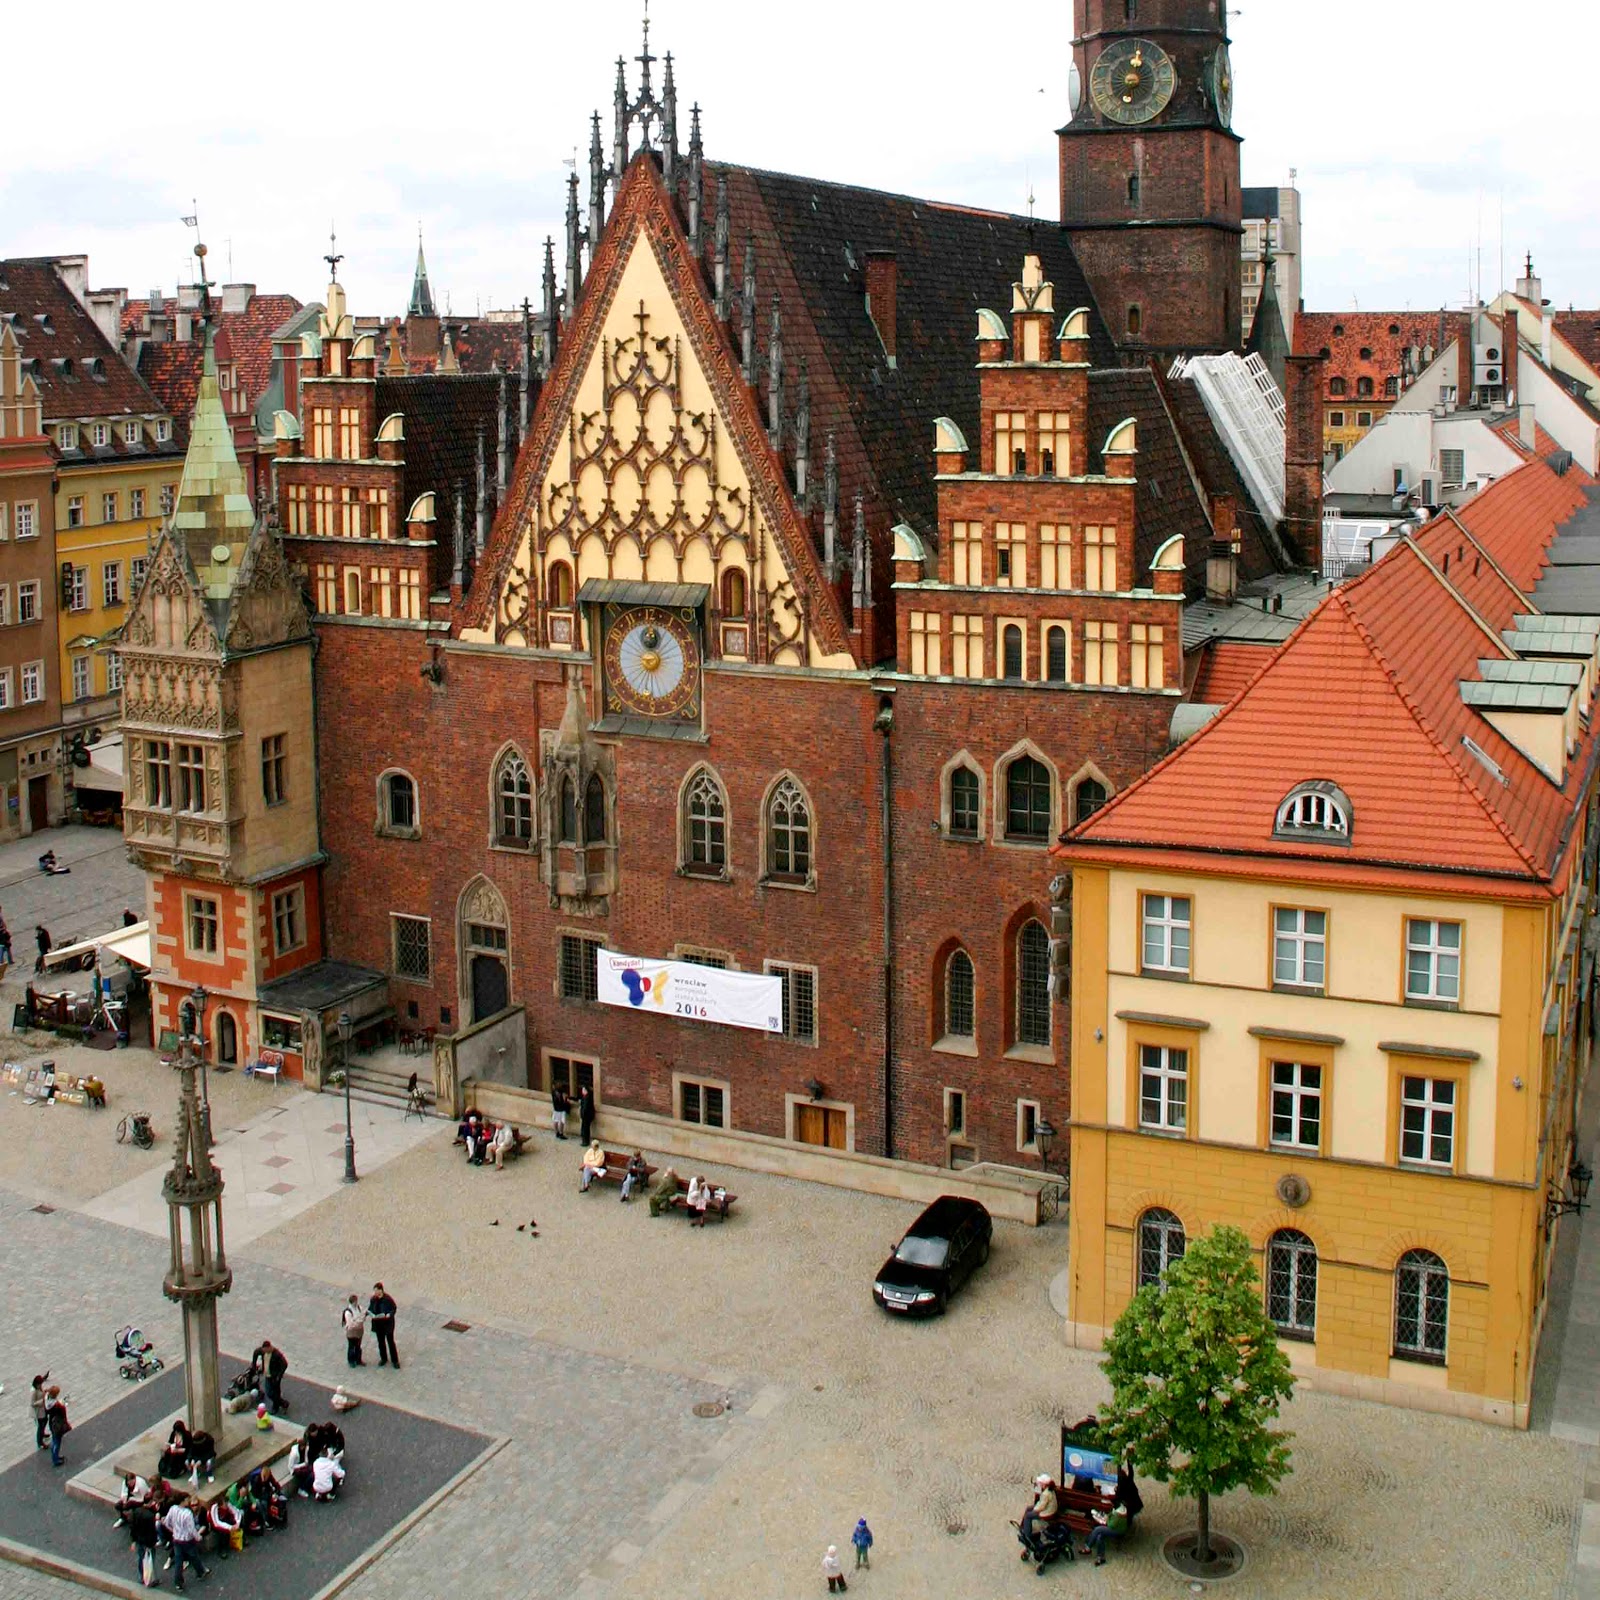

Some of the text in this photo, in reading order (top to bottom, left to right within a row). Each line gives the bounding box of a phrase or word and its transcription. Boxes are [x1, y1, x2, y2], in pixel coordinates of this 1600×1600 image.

[625, 613, 635, 628] 11
[645, 608, 656, 621] 12
[610, 628, 622, 644] 10
[675, 1002, 707, 1017] 2016
